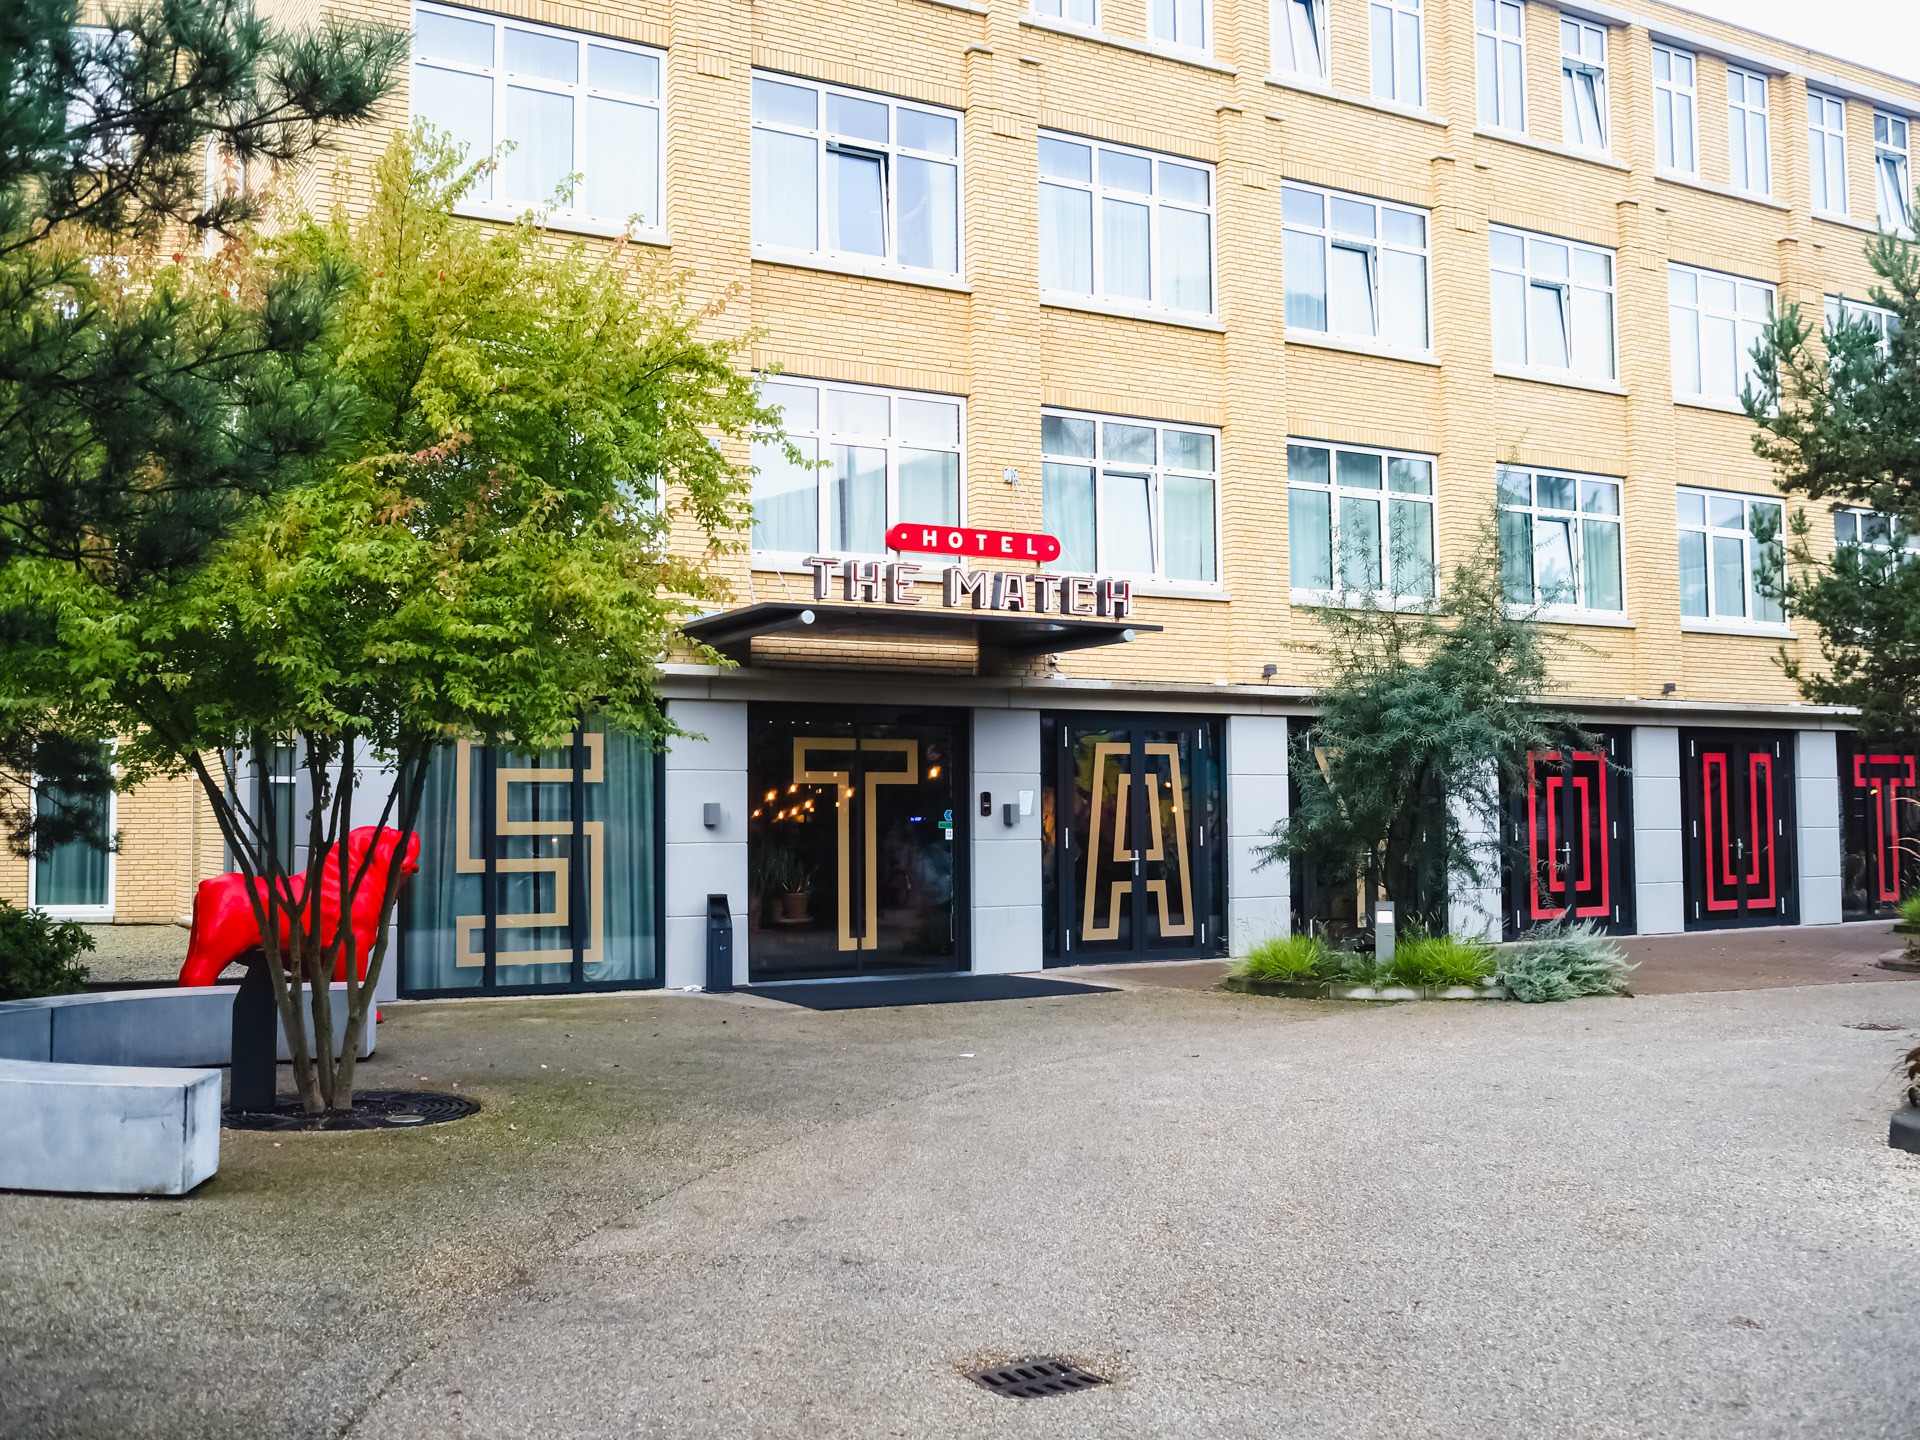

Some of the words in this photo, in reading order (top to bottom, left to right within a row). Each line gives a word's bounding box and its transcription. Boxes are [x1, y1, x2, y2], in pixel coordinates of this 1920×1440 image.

[922, 529, 1038, 556] HOTEL
[803, 556, 923, 605] THE
[943, 567, 1133, 617] MATCH
